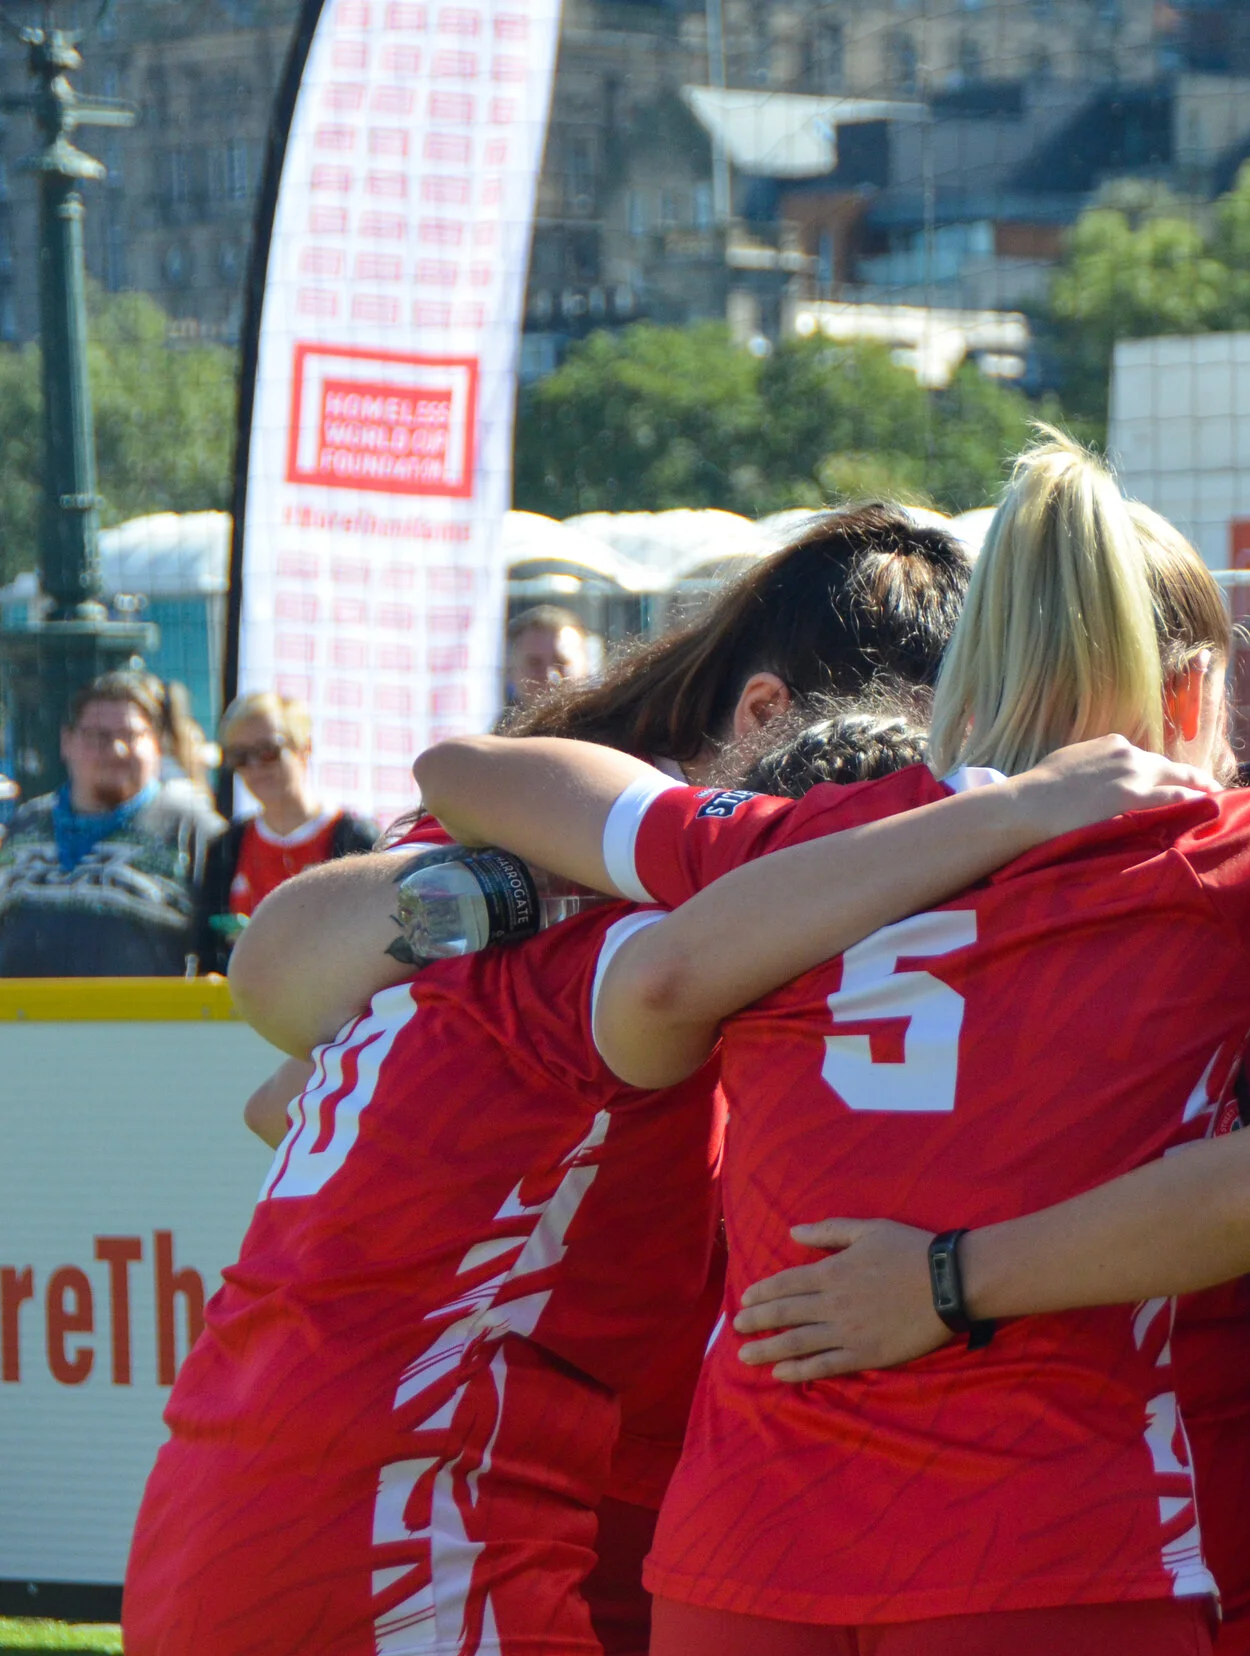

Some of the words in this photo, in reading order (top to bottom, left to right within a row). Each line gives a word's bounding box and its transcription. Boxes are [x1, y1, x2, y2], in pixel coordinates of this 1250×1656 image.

[325, 391, 450, 427] HOMELESS
[495, 855, 529, 924] HARROGATE
[821, 909, 977, 1112] 5
